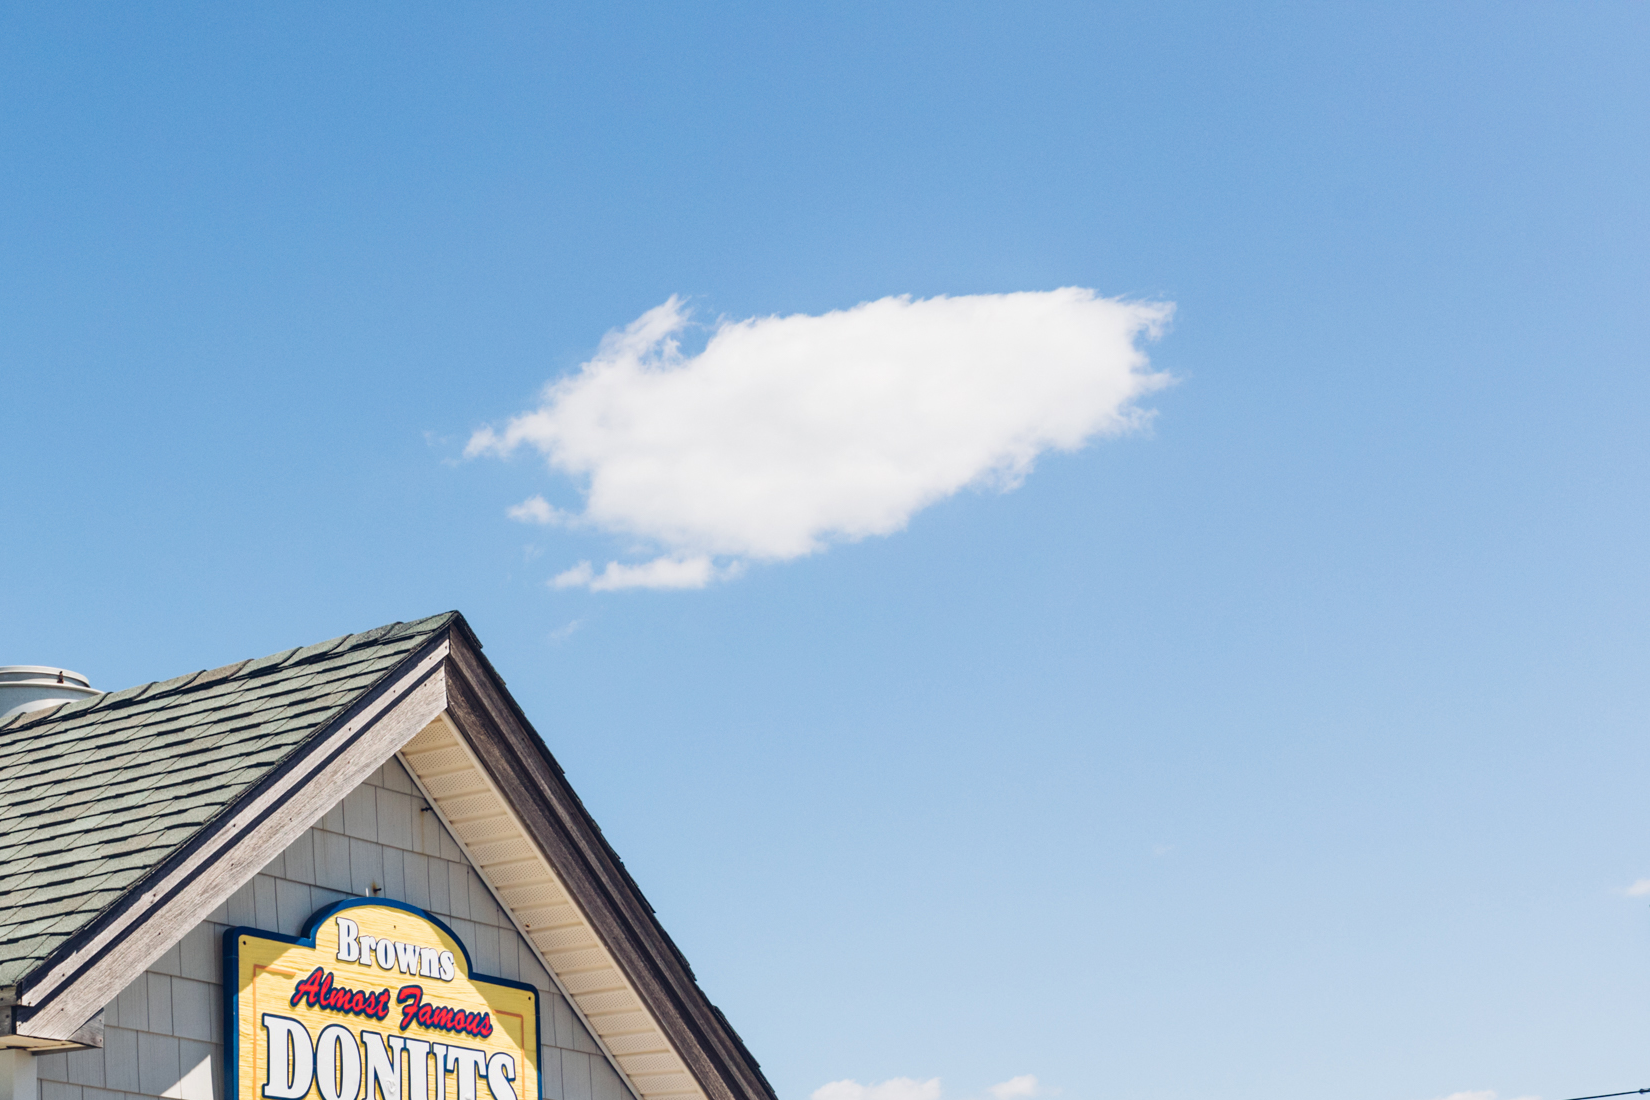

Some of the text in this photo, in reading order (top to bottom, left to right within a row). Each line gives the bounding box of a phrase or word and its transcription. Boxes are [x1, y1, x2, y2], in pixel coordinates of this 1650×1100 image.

[336, 917, 455, 981] Browns
[290, 966, 493, 1038] Almost Famous
